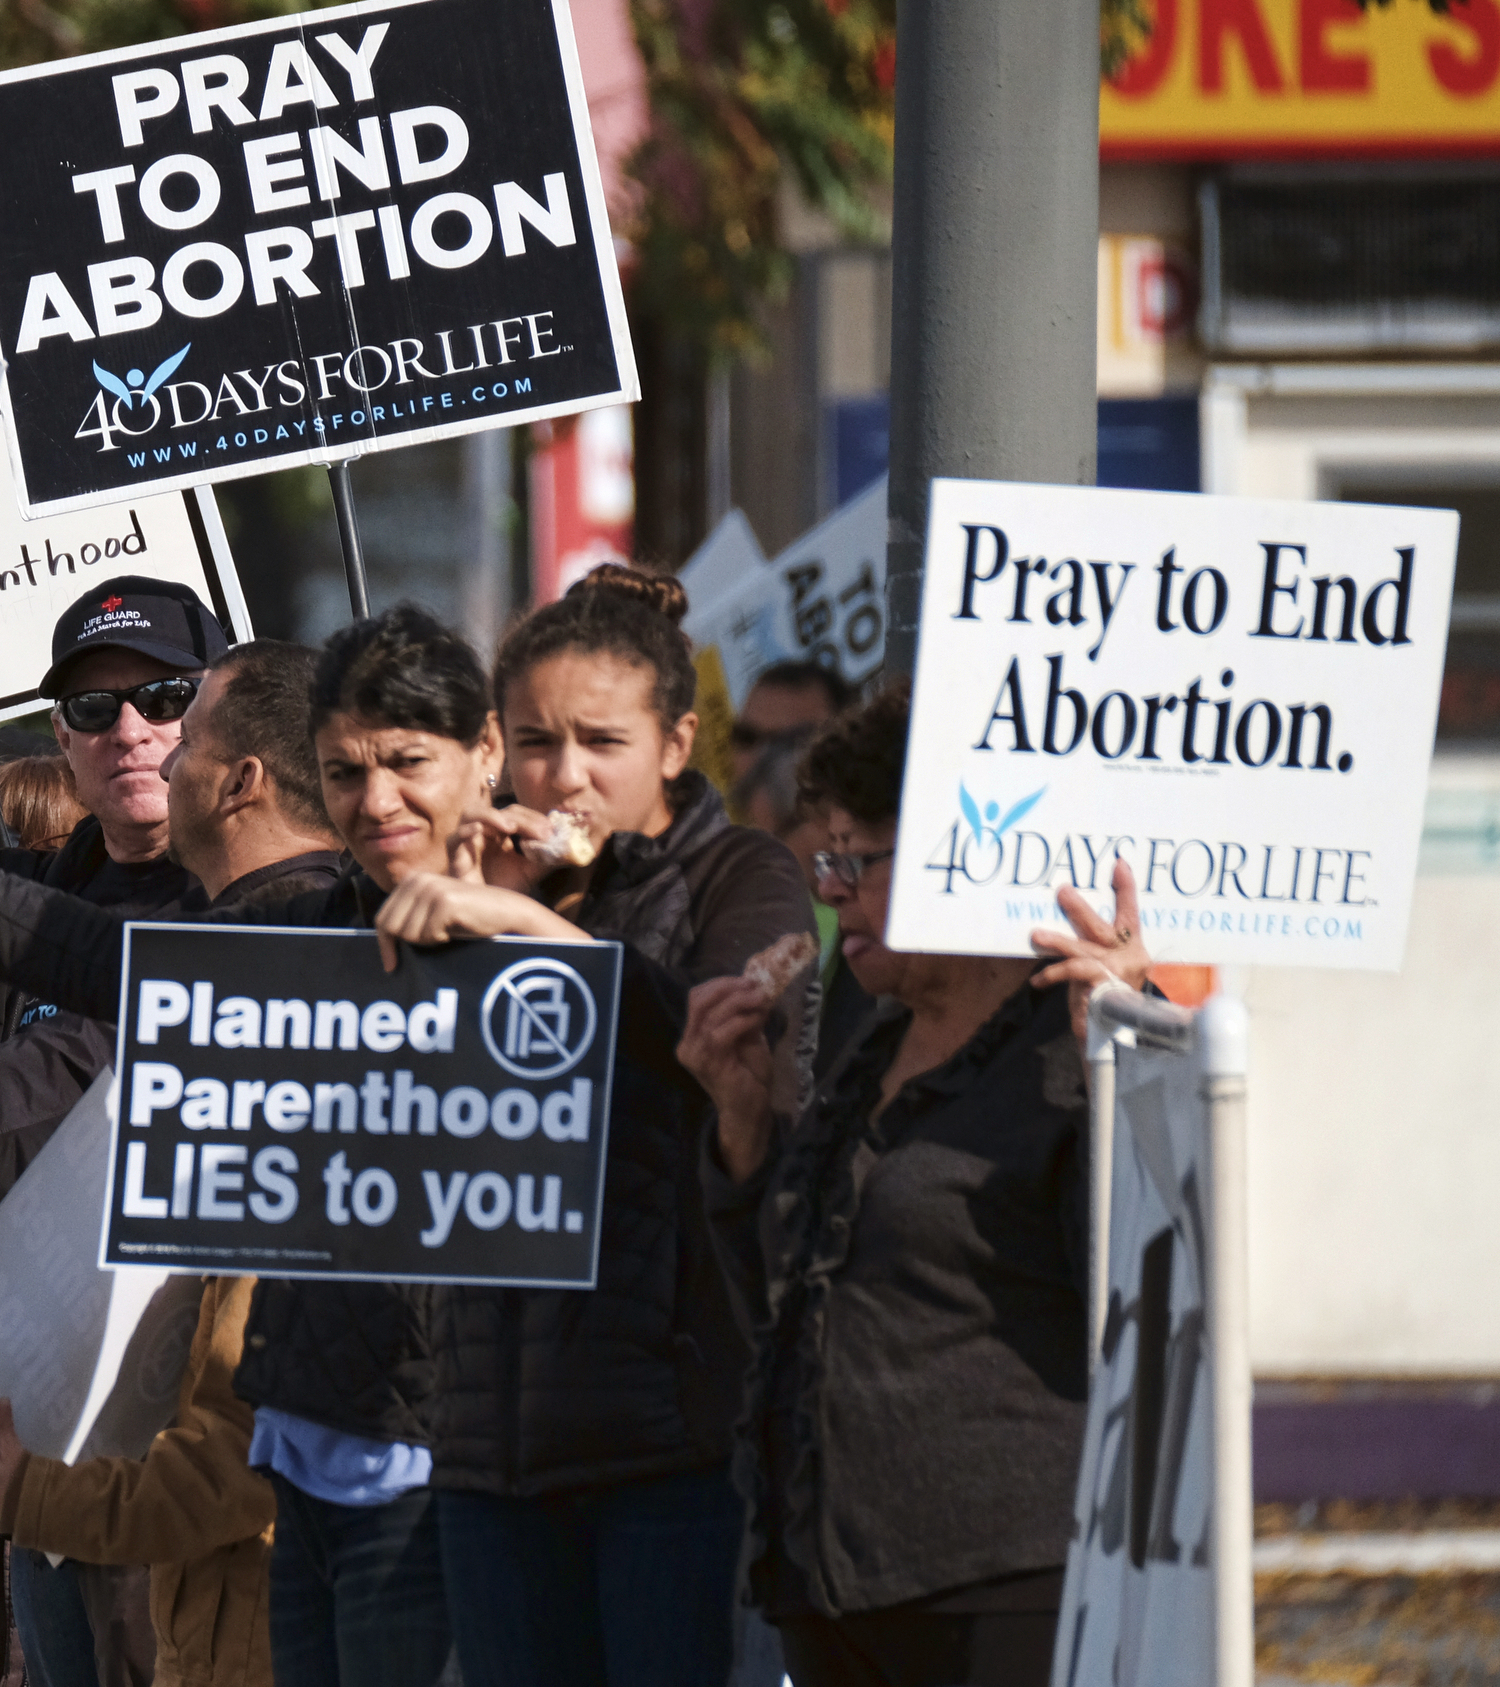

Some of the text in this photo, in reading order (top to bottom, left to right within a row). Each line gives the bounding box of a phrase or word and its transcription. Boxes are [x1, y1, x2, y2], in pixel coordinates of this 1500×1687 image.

[111, 22, 391, 148] PRAY
[72, 105, 470, 244] TO END
[15, 172, 578, 354] ABORTION
[126, 376, 533, 469] WWW.40DAYSFORLIFE.COM
[83, 611, 141, 630] LIFE GUARD
[951, 522, 1416, 661] Pray to End
[973, 653, 1355, 774] Abortion.
[20, 1004, 58, 1027] AY TO
[136, 979, 458, 1053] Planned
[130, 1062, 593, 1142] Parenthood
[122, 1141, 300, 1222] LIES
[323, 1151, 398, 1226] to
[419, 1168, 585, 1247] you.
